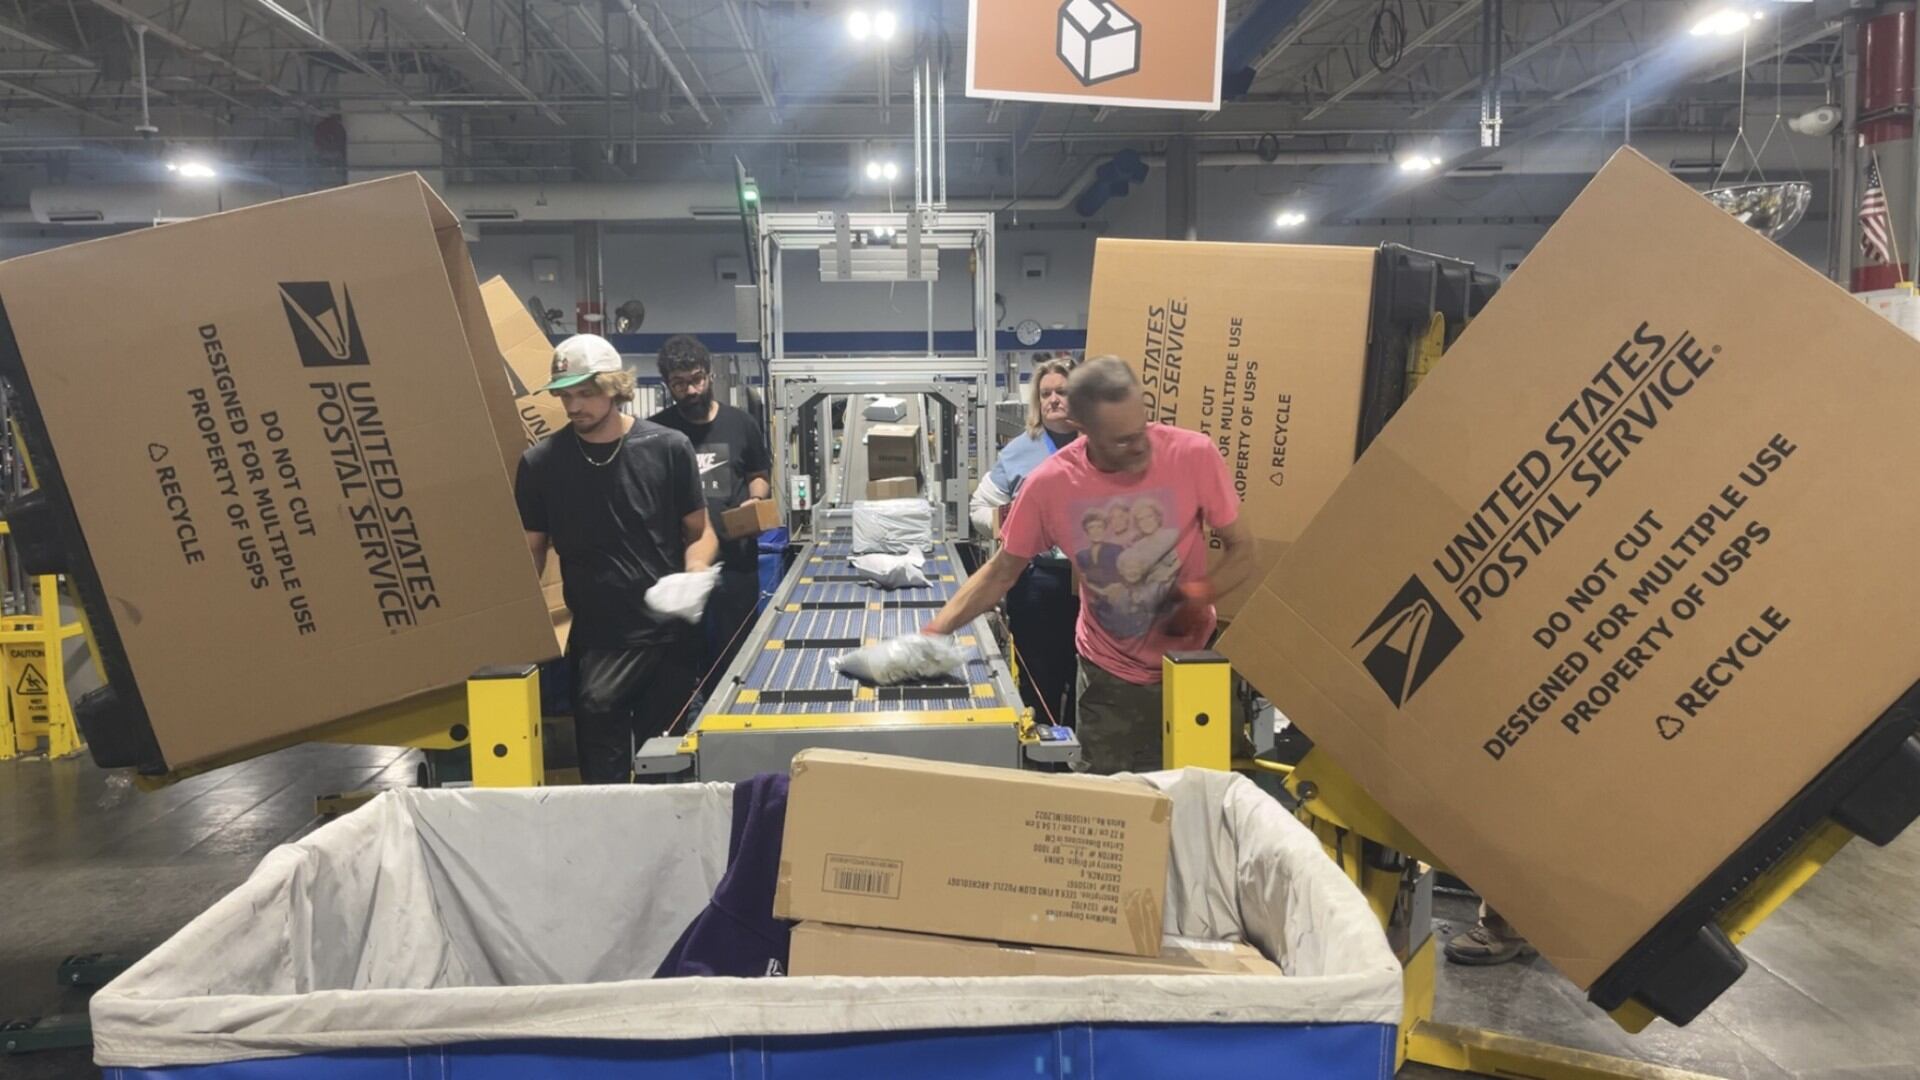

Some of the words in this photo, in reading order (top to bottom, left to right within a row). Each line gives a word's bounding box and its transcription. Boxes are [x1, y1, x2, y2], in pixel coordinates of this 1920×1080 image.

[1143, 305, 1164, 388] STATES
[1162, 300, 1188, 398] SERVICE
[1228, 318, 1242, 347] USE
[1202, 386, 1215, 416] CUT
[1220, 353, 1238, 430] MULTIPLE
[1243, 362, 1258, 401] USPS
[187, 388, 238, 496] PROPERTY
[1219, 436, 1230, 457] OR
[1241, 406, 1253, 426] OF
[1272, 394, 1291, 467] RECYCLE
[198, 324, 248, 434] DESIGNED
[237, 440, 264, 484] FOR
[253, 488, 301, 591] MULTIPLE
[290, 596, 316, 635] USE
[260, 411, 284, 442] DO
[272, 448, 301, 490] NOT
[289, 497, 316, 536] CUT
[1235, 430, 1250, 502] OPERTY
[1433, 450, 1550, 583] UNITED
[1546, 321, 1666, 460] STATES
[1459, 493, 1582, 621] POSTAL
[1571, 336, 1714, 498] SERVICE
[156, 466, 205, 564] RECYCLE
[309, 382, 367, 498] POSTAL
[348, 505, 411, 628] SERVICE
[346, 382, 403, 499] UNITED
[384, 506, 440, 610] STATES
[701, 480, 719, 489] IR
[227, 504, 250, 530] OF
[238, 536, 268, 589] USPS
[1532, 612, 1571, 649] DO
[1566, 558, 1617, 613] NOT
[1614, 509, 1663, 561] CUT
[1483, 652, 1588, 760] DESIGNED
[1584, 604, 1638, 654] FOR
[1629, 485, 1748, 605] MULTIPLE
[1739, 433, 1797, 486] USE
[1561, 616, 1674, 734] PROPERTY
[1671, 583, 1705, 620] OF
[1702, 521, 1770, 586] USPS
[10, 649, 45, 658] CAUTION
[1675, 606, 1790, 717] RECYCLE
[1044, 855, 1064, 864] CHINA
[1063, 836, 1101, 847] Dimensions
[1097, 861, 1122, 871] Country
[1098, 852, 1123, 860] CARTON
[1102, 841, 1124, 850] Carton
[1019, 886, 1037, 894] GLOW
[1038, 888, 1053, 896] FIND
[1046, 909, 1084, 919] Corporation
